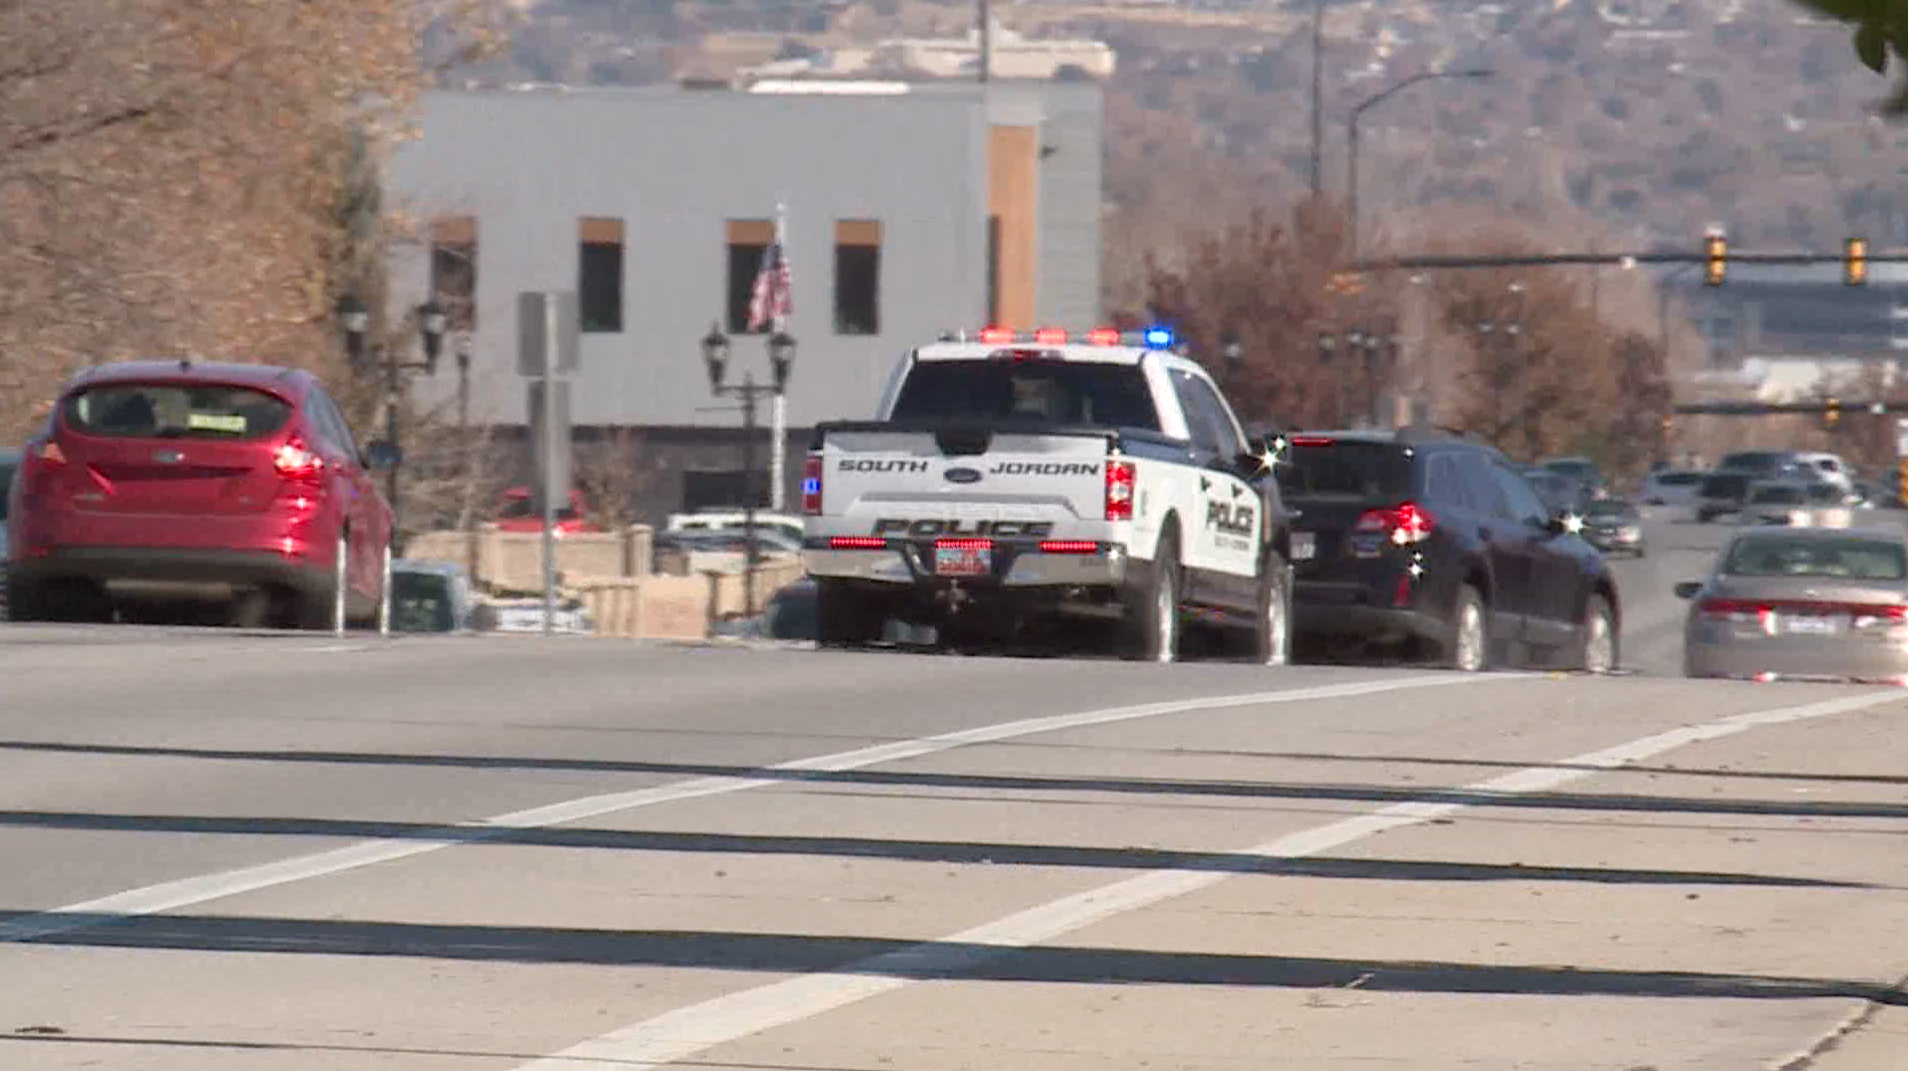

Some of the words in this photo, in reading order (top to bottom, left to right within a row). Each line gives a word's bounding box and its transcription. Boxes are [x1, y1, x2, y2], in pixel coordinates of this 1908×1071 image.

[838, 459, 929, 474] SOUTH
[989, 461, 1101, 476] JORDAN
[872, 518, 1056, 538] POLICE
[1206, 501, 1254, 536] POLICE
